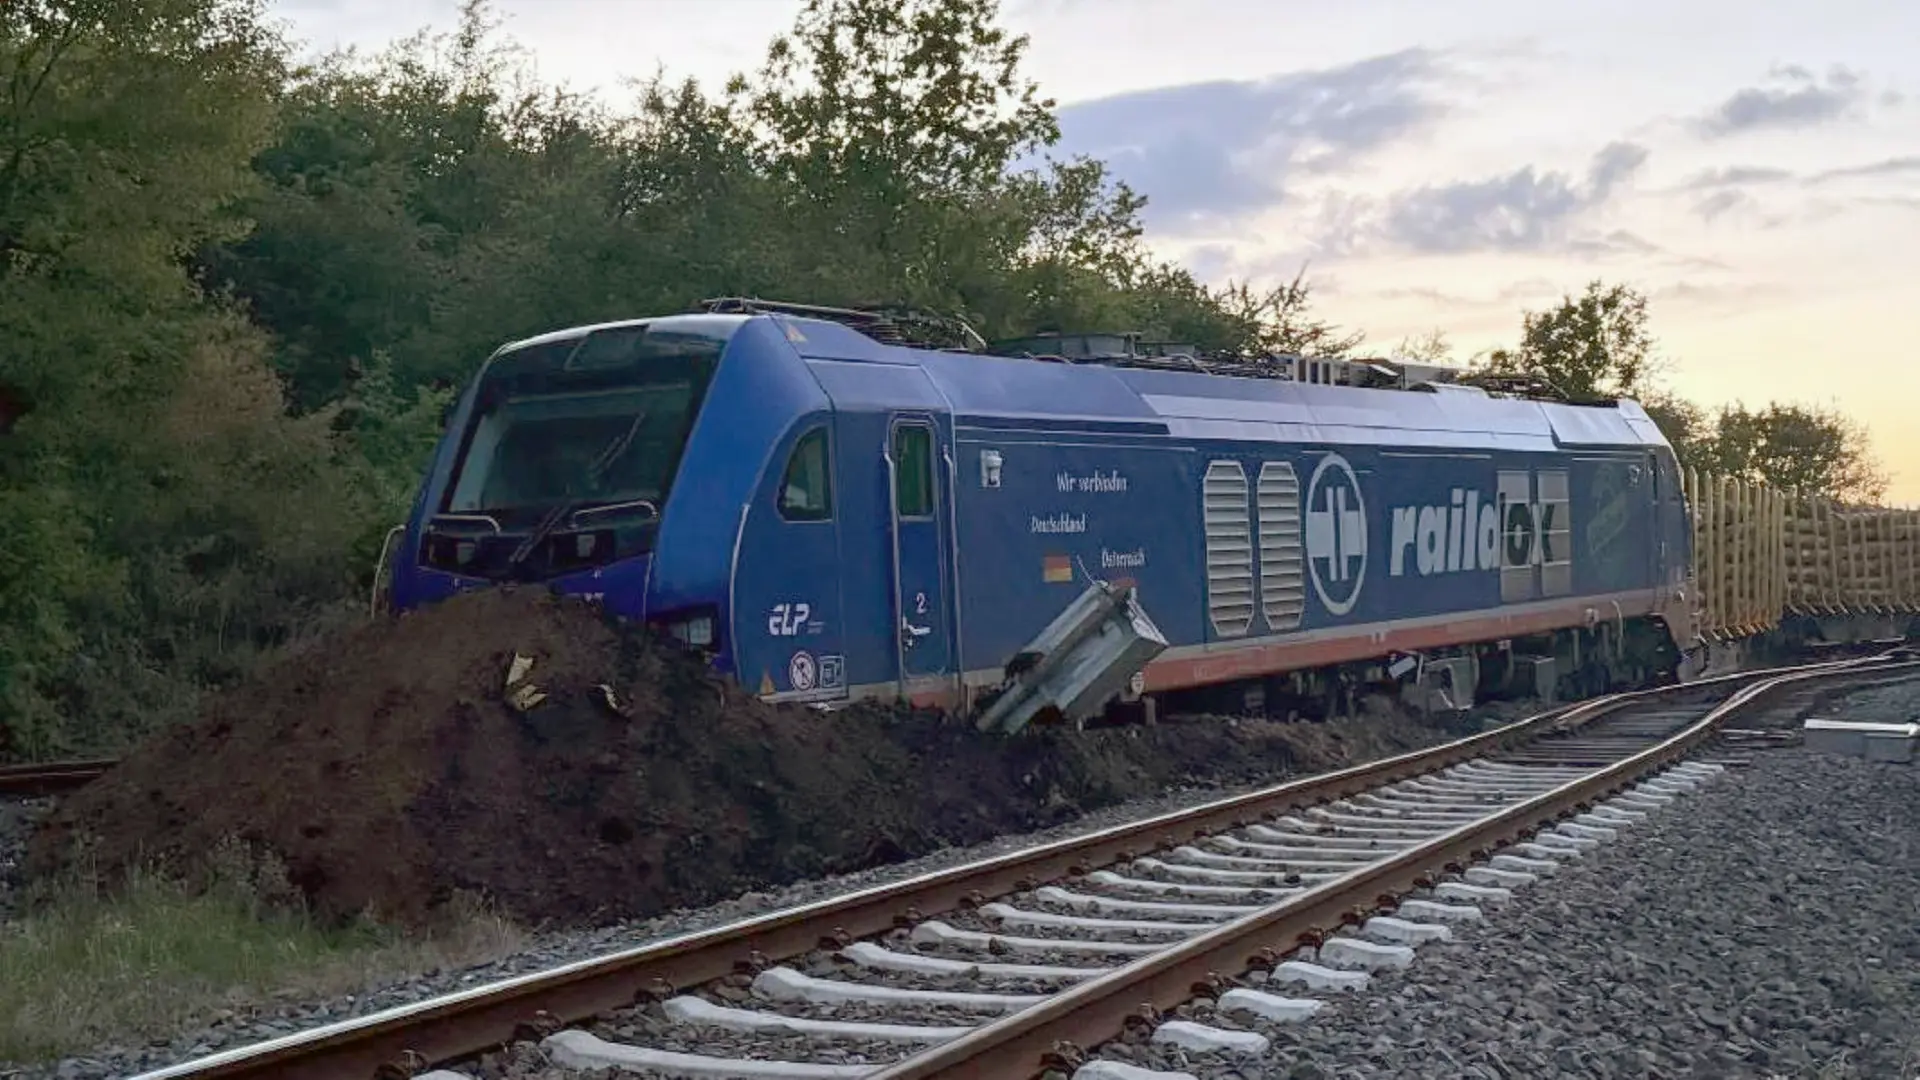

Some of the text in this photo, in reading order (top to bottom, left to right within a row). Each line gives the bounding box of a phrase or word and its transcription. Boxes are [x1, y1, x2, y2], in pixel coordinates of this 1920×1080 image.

[1056, 469, 1128, 493] Wir verbinden
[1031, 512, 1086, 533] Deutschland
[1389, 488, 1555, 577] raildox
[915, 592, 927, 615] 2
[768, 603, 811, 636] ELP
